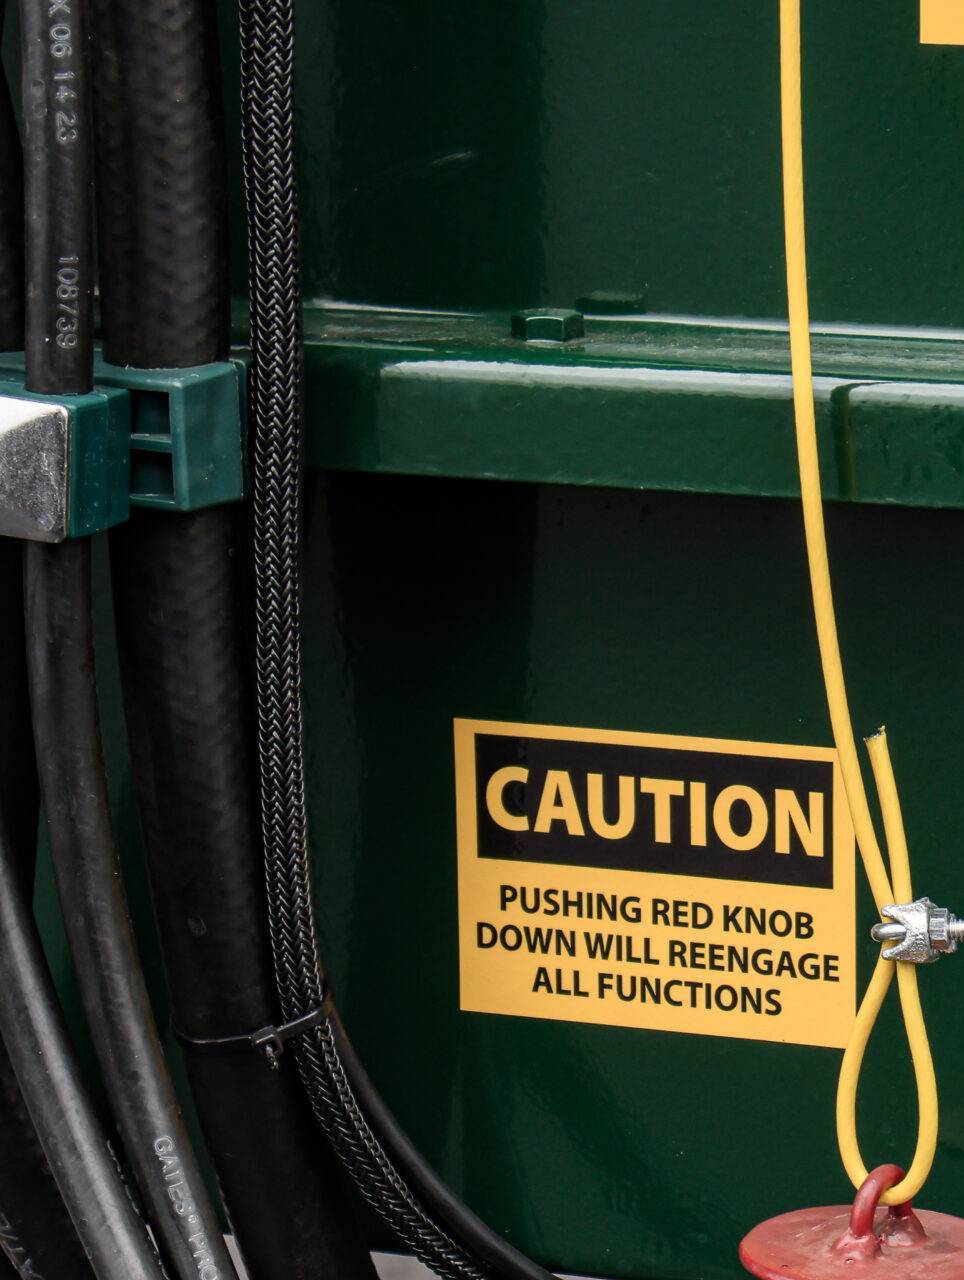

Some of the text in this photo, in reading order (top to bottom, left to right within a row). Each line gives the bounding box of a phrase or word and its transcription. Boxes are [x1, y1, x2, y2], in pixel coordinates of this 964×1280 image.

[50, 24, 72, 58] 06
[54, 70, 78, 104] 14
[56, 111, 78, 144] 23
[55, 255, 80, 349] 108739
[485, 766, 824, 858] CAUTION
[499, 884, 814, 940] PUSHING RED KNOB
[476, 921, 840, 982] DOWN WILL REENGAGE
[531, 966, 782, 1017] ALL FUNCTIONS
